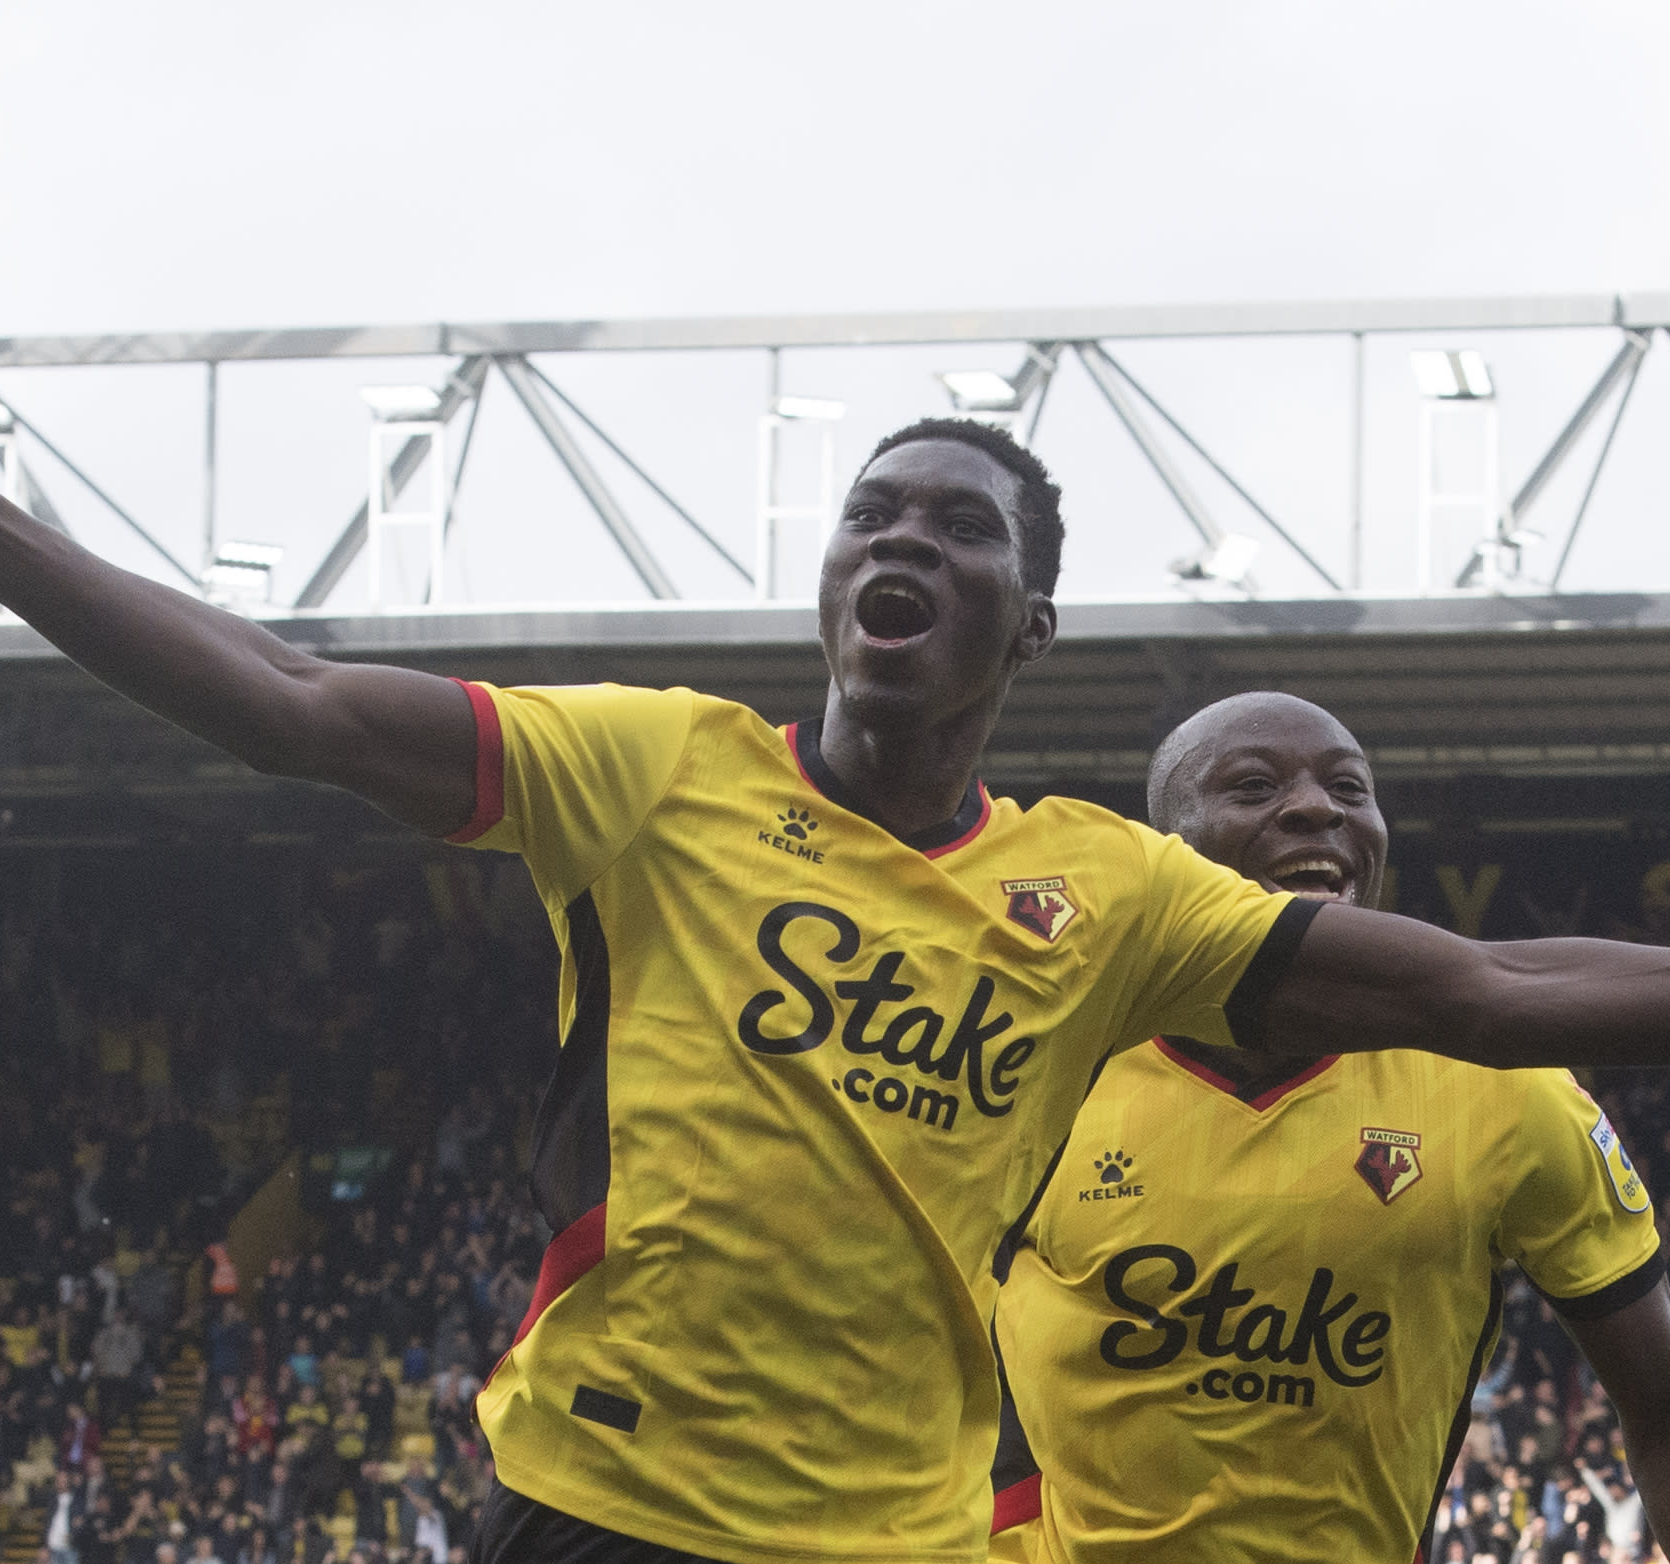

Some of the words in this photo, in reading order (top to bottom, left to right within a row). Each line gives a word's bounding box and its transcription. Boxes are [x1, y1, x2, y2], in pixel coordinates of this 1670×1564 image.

[757, 831, 825, 864] KELME
[1007, 880, 1060, 891] WATFORD
[1380, 864, 1504, 937] Y
[737, 901, 1036, 1118] Stake
[831, 1068, 960, 1130] .com
[1366, 1130, 1417, 1145] WATFORD
[1079, 1186, 1144, 1202] KELME
[1099, 1244, 1392, 1387] Stake
[1186, 1368, 1316, 1407] .com
